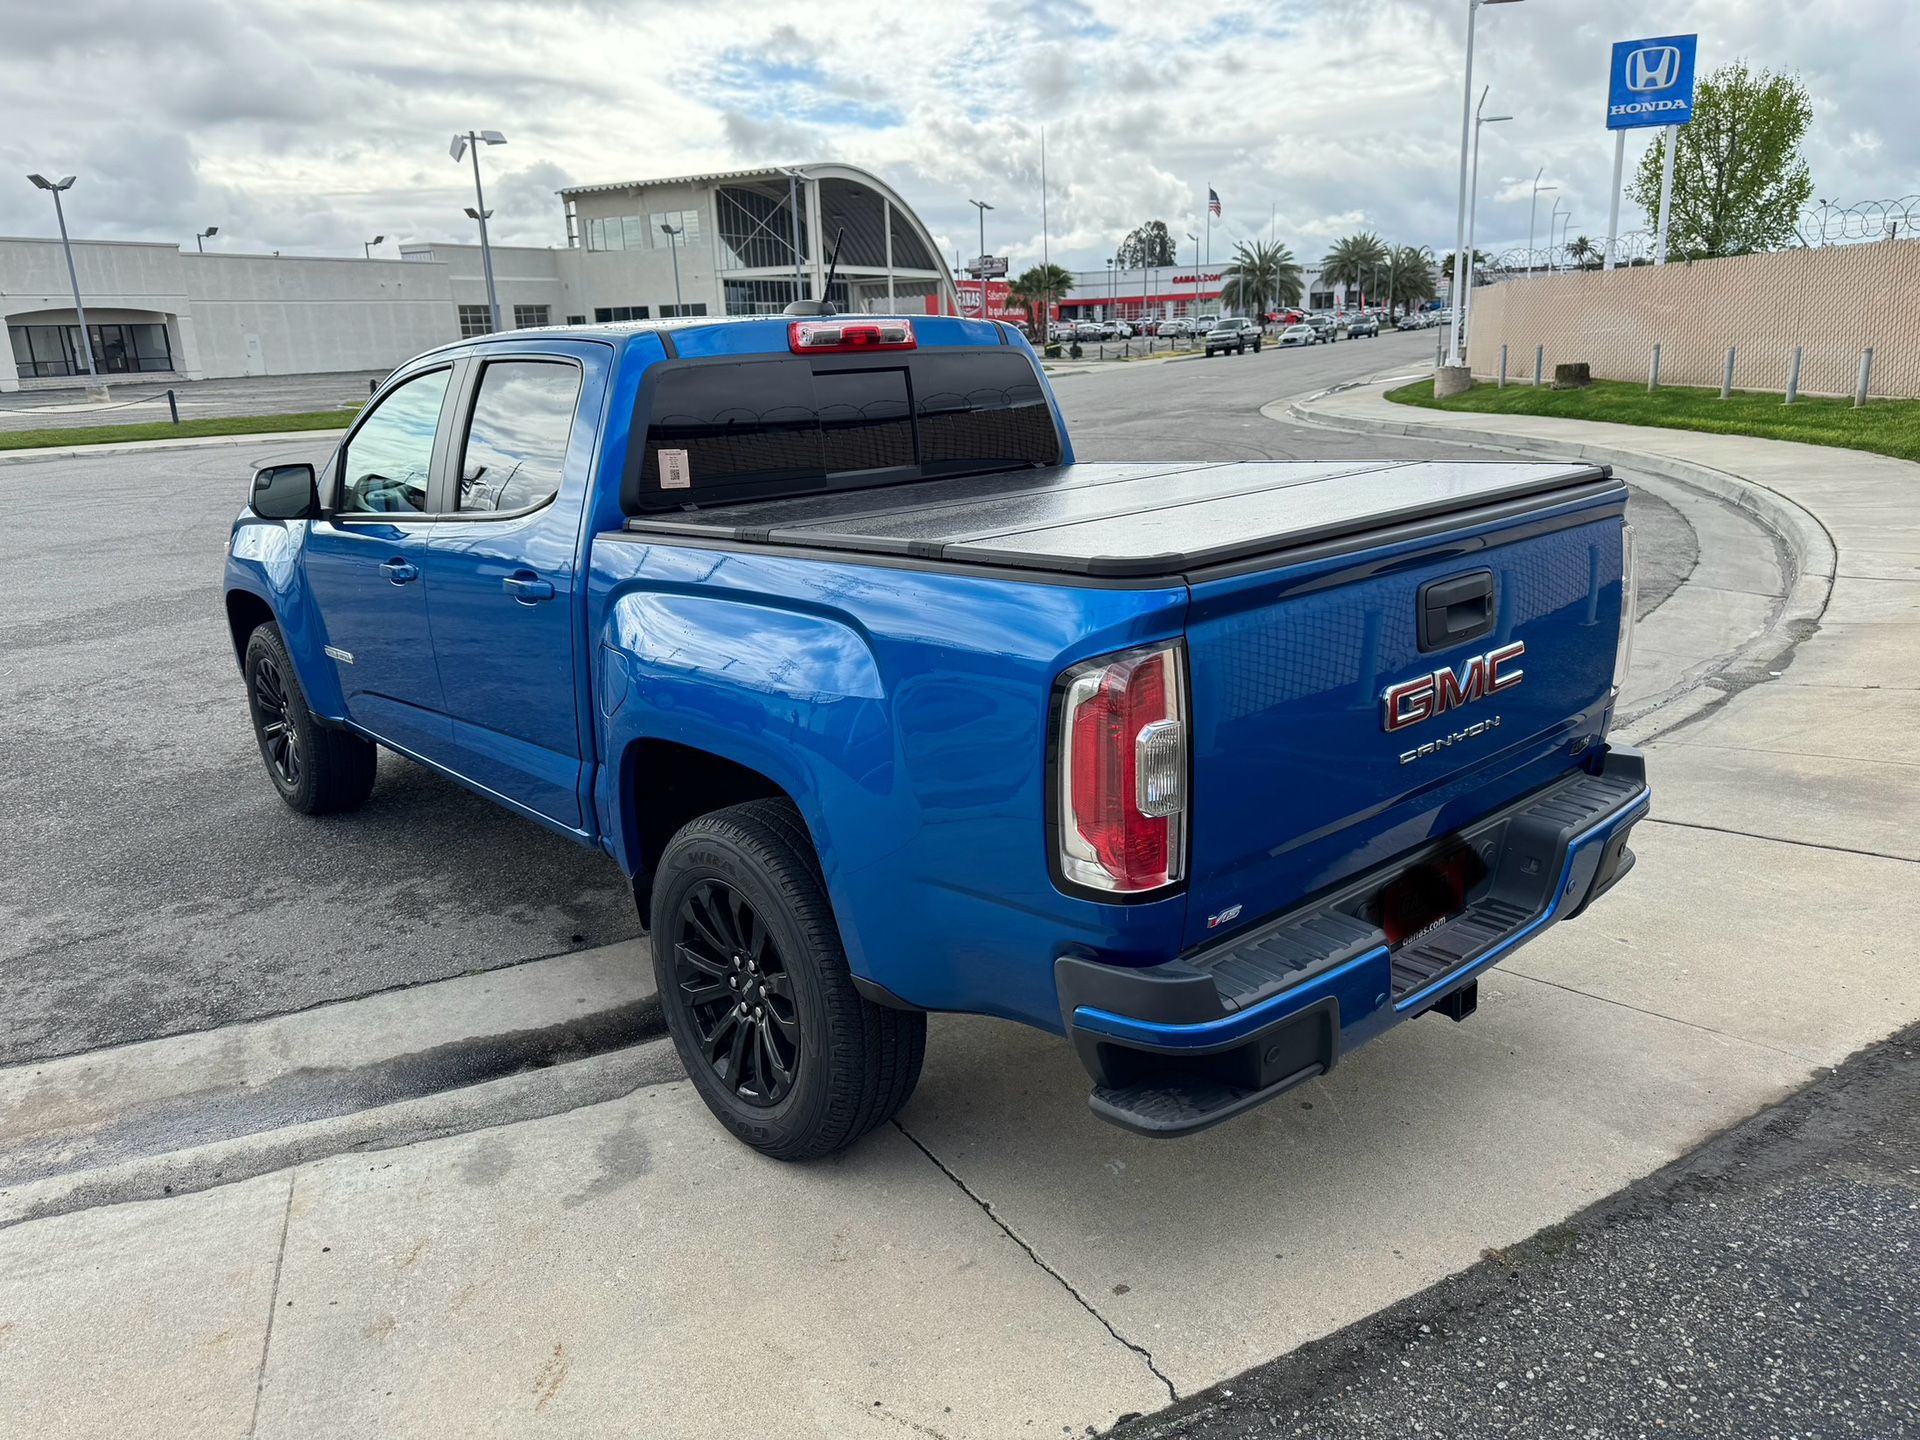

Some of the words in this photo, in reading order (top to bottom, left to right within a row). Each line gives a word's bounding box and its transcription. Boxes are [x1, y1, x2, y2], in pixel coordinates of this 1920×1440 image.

[1610, 99, 1688, 115] HONDA
[1382, 640, 1524, 732] GMC
[1399, 715, 1500, 765] CANYON
